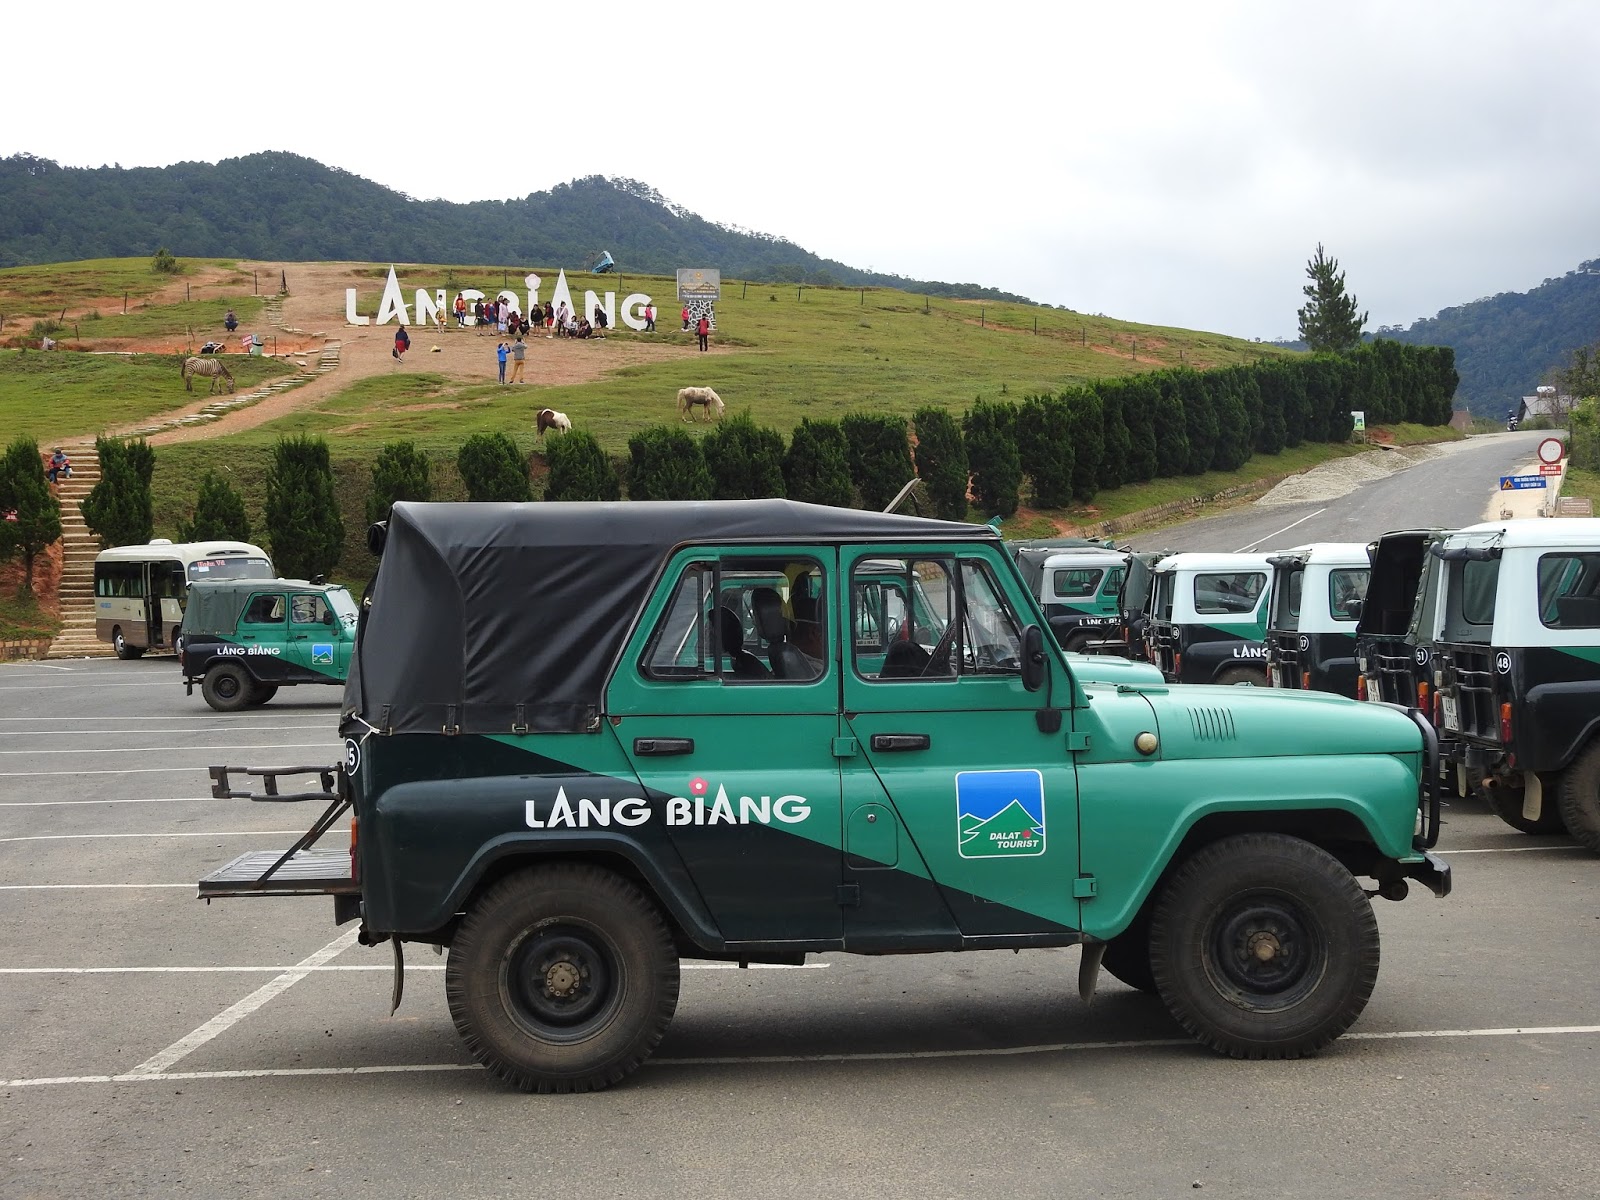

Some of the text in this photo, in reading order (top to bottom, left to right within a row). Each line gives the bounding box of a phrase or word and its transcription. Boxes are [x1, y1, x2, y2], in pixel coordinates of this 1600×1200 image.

[216, 644, 281, 656] LANG BIANG
[1497, 657, 1509, 669] 48
[346, 747, 356, 766] 5
[525, 778, 812, 828] LANG BIANG
[989, 831, 1021, 841] DALAT
[997, 839, 1040, 849] TOURIST
